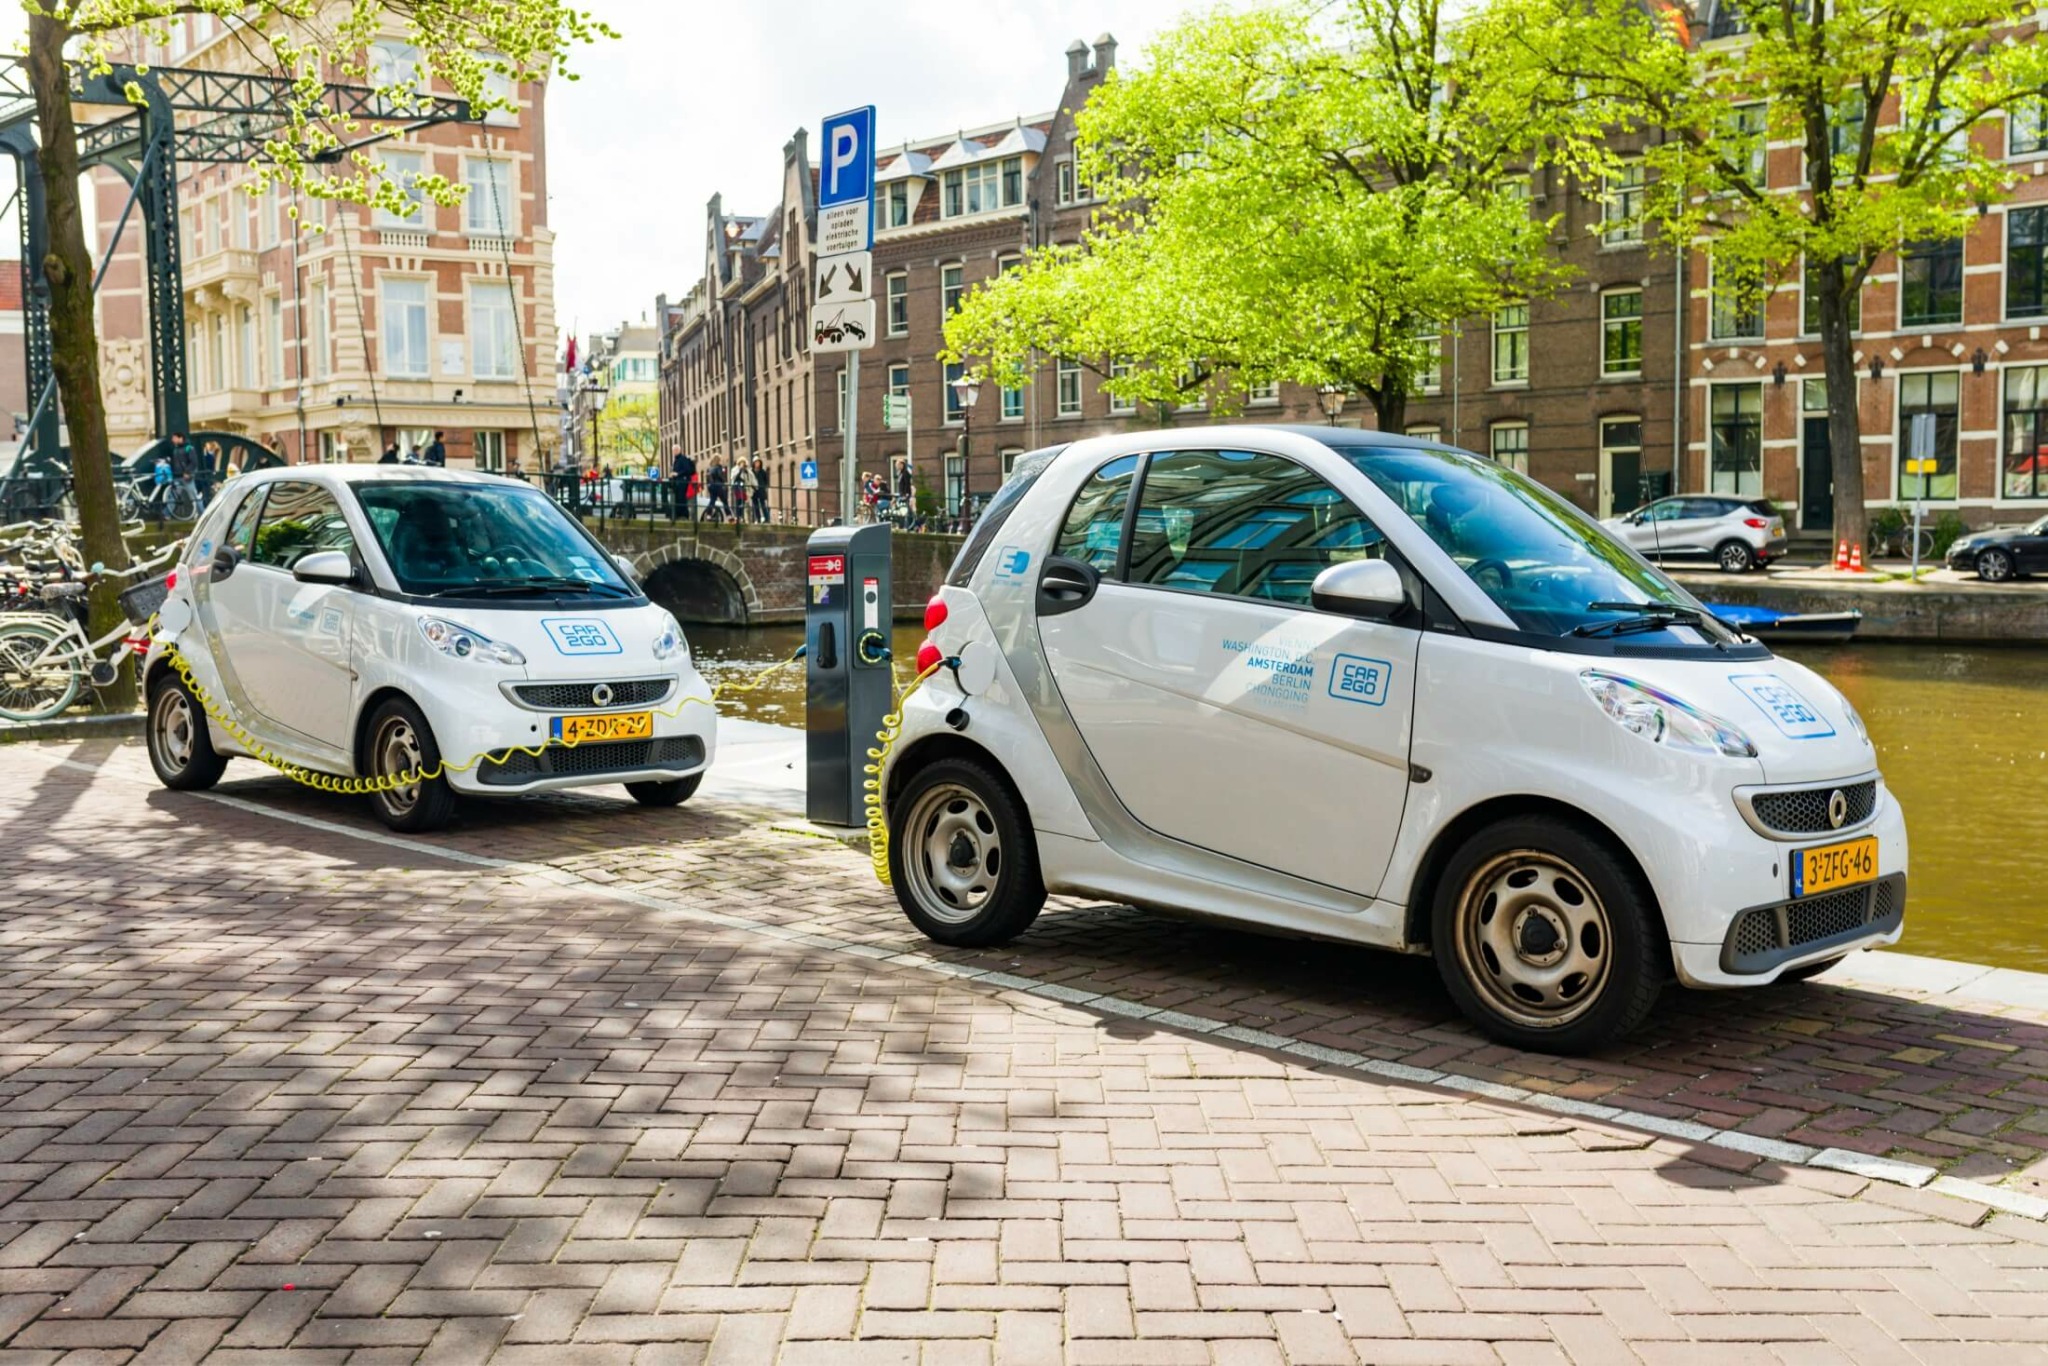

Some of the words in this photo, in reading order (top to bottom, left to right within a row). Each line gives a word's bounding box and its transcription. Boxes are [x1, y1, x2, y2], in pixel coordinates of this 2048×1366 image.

[831, 124, 858, 195] P
[826, 210, 844, 220] alleen
[845, 207, 859, 215] voor
[559, 625, 601, 635] CAR
[566, 635, 607, 647] 2GO
[1247, 656, 1314, 678] AMSTERDAM
[1344, 664, 1378, 682] CAR
[1271, 673, 1311, 691] BERLIN
[1341, 678, 1376, 695] 2GO
[1773, 704, 1816, 723] 2GO
[1809, 844, 1872, 886] 3-ZFG-46
